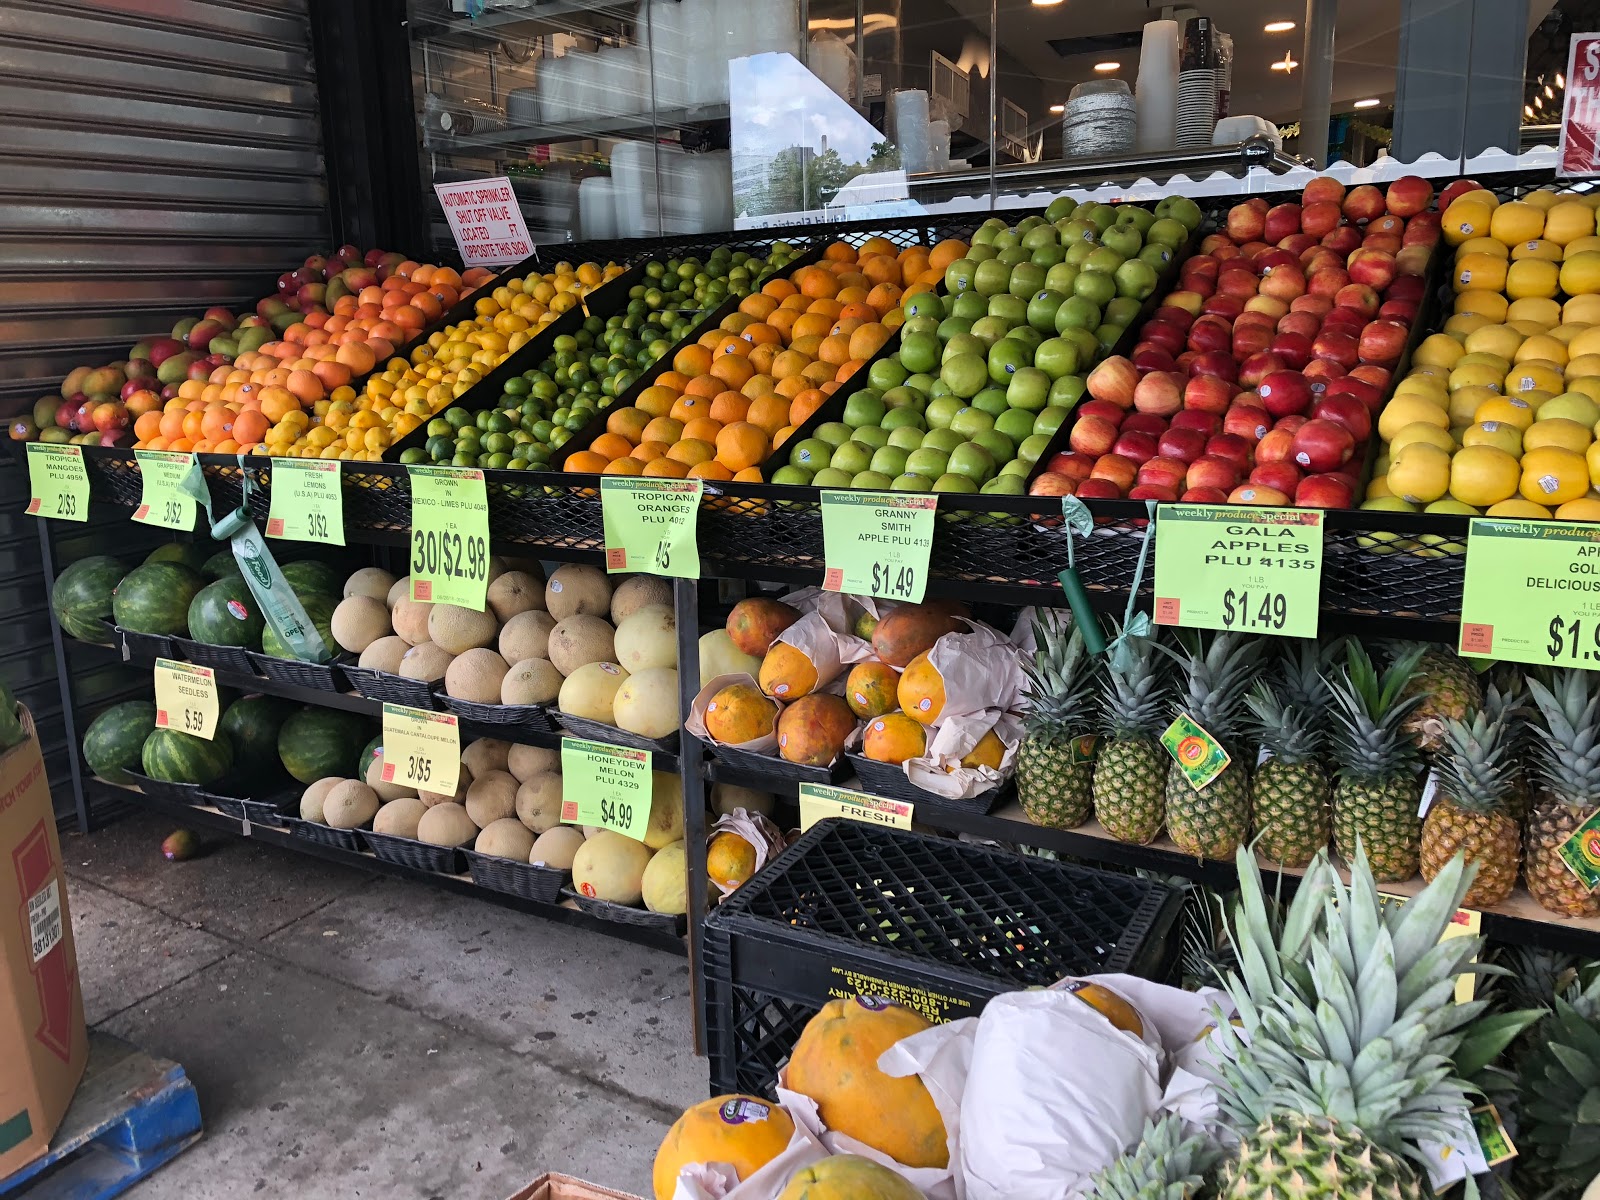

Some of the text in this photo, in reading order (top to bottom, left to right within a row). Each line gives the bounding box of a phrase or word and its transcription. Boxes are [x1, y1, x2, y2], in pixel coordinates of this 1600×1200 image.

[443, 187, 512, 207] AUTOMATIC SPRINKLER
[455, 206, 511, 224] SHUT OFF VALVE
[458, 223, 522, 241] LOCATED FT.
[464, 240, 530, 258] OPPOSITE THIS SIGN
[45, 455, 81, 463] TROPICAL
[46, 464, 83, 472] MANGOES
[157, 463, 185, 471] GRAPEFRUIT
[434, 478, 459, 487] GROWN
[612, 480, 635, 488] weekly
[412, 497, 436, 506] MEXICO
[441, 500, 460, 509] LIMES
[460, 501, 473, 510] PLU
[631, 492, 695, 502] TROPICANA
[834, 494, 925, 507] weekly produce special
[57, 493, 76, 517] 2/$3
[637, 504, 691, 514] ORANGES
[164, 501, 182, 525] 3/$2
[875, 509, 917, 519] GRANNY
[1176, 509, 1301, 524] weekly produce special
[308, 513, 328, 539] 3/$2
[669, 516, 685, 525] 4012
[881, 522, 911, 532] SMITH
[1226, 526, 1295, 537] GALA
[1493, 524, 1600, 538] weekly produce
[858, 533, 889, 543] APPLE
[892, 536, 911, 545] PLU
[1211, 540, 1310, 553] APPLES
[1577, 545, 1600, 557] AP
[413, 529, 486, 581] 30/$2.98
[1205, 555, 1252, 566] PLU
[871, 561, 914, 598] $1.49
[1526, 577, 1600, 592] DELICIOUS
[1222, 588, 1287, 630] $1.49
[172, 672, 212, 687] WATERMELON
[178, 686, 209, 699] SEEDLESS
[185, 708, 203, 731] $.59
[440, 737, 457, 745] MELON
[571, 742, 592, 750] weekly
[587, 754, 645, 770] HONEYDEW
[408, 755, 432, 783] 3/$5
[599, 766, 634, 778] MELON
[595, 775, 639, 790] PLU 4329
[812, 786, 897, 810] weekly produce special
[601, 797, 633, 829] $4.99
[841, 805, 896, 824] FRESH
[831, 966, 844, 975] LAW
[853, 971, 889, 987] PUNISHABLE
[846, 976, 950, 1010] 1-800-323-0123
[888, 981, 910, 992] OWNER
[910, 987, 926, 996] THAN
[928, 992, 947, 1001] OTHER
[958, 999, 970, 1008] USE
